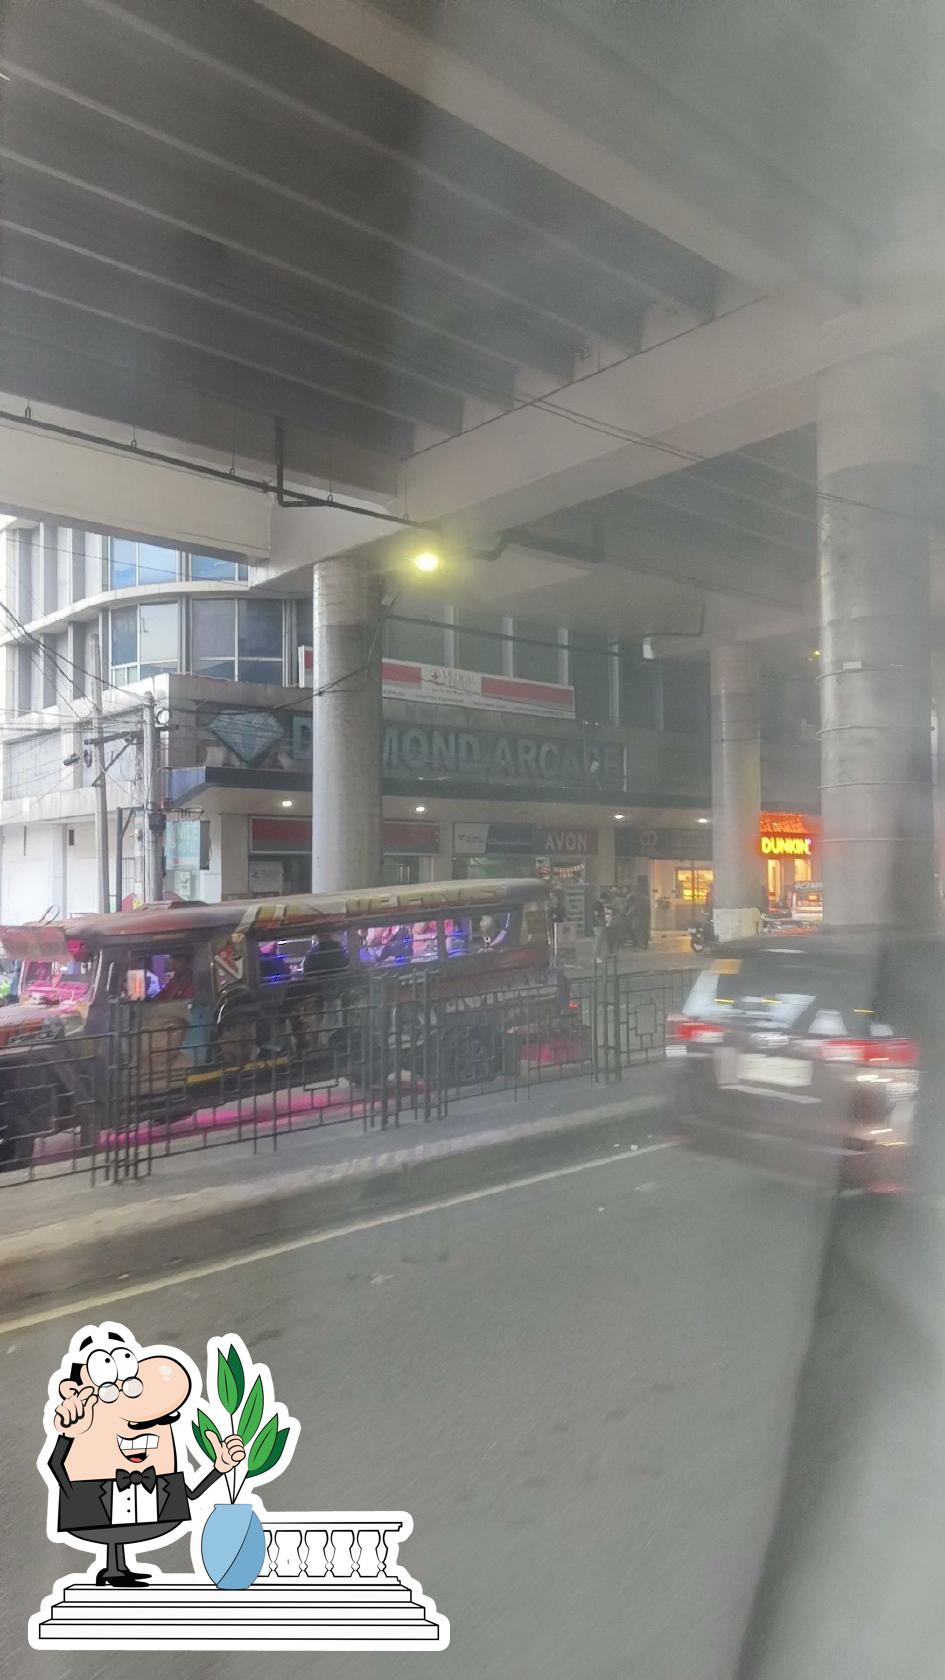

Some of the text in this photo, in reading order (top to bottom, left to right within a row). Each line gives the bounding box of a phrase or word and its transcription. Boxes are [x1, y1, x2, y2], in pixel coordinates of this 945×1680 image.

[292, 716, 621, 780] DMOND ARCADE
[544, 831, 587, 851] AVON
